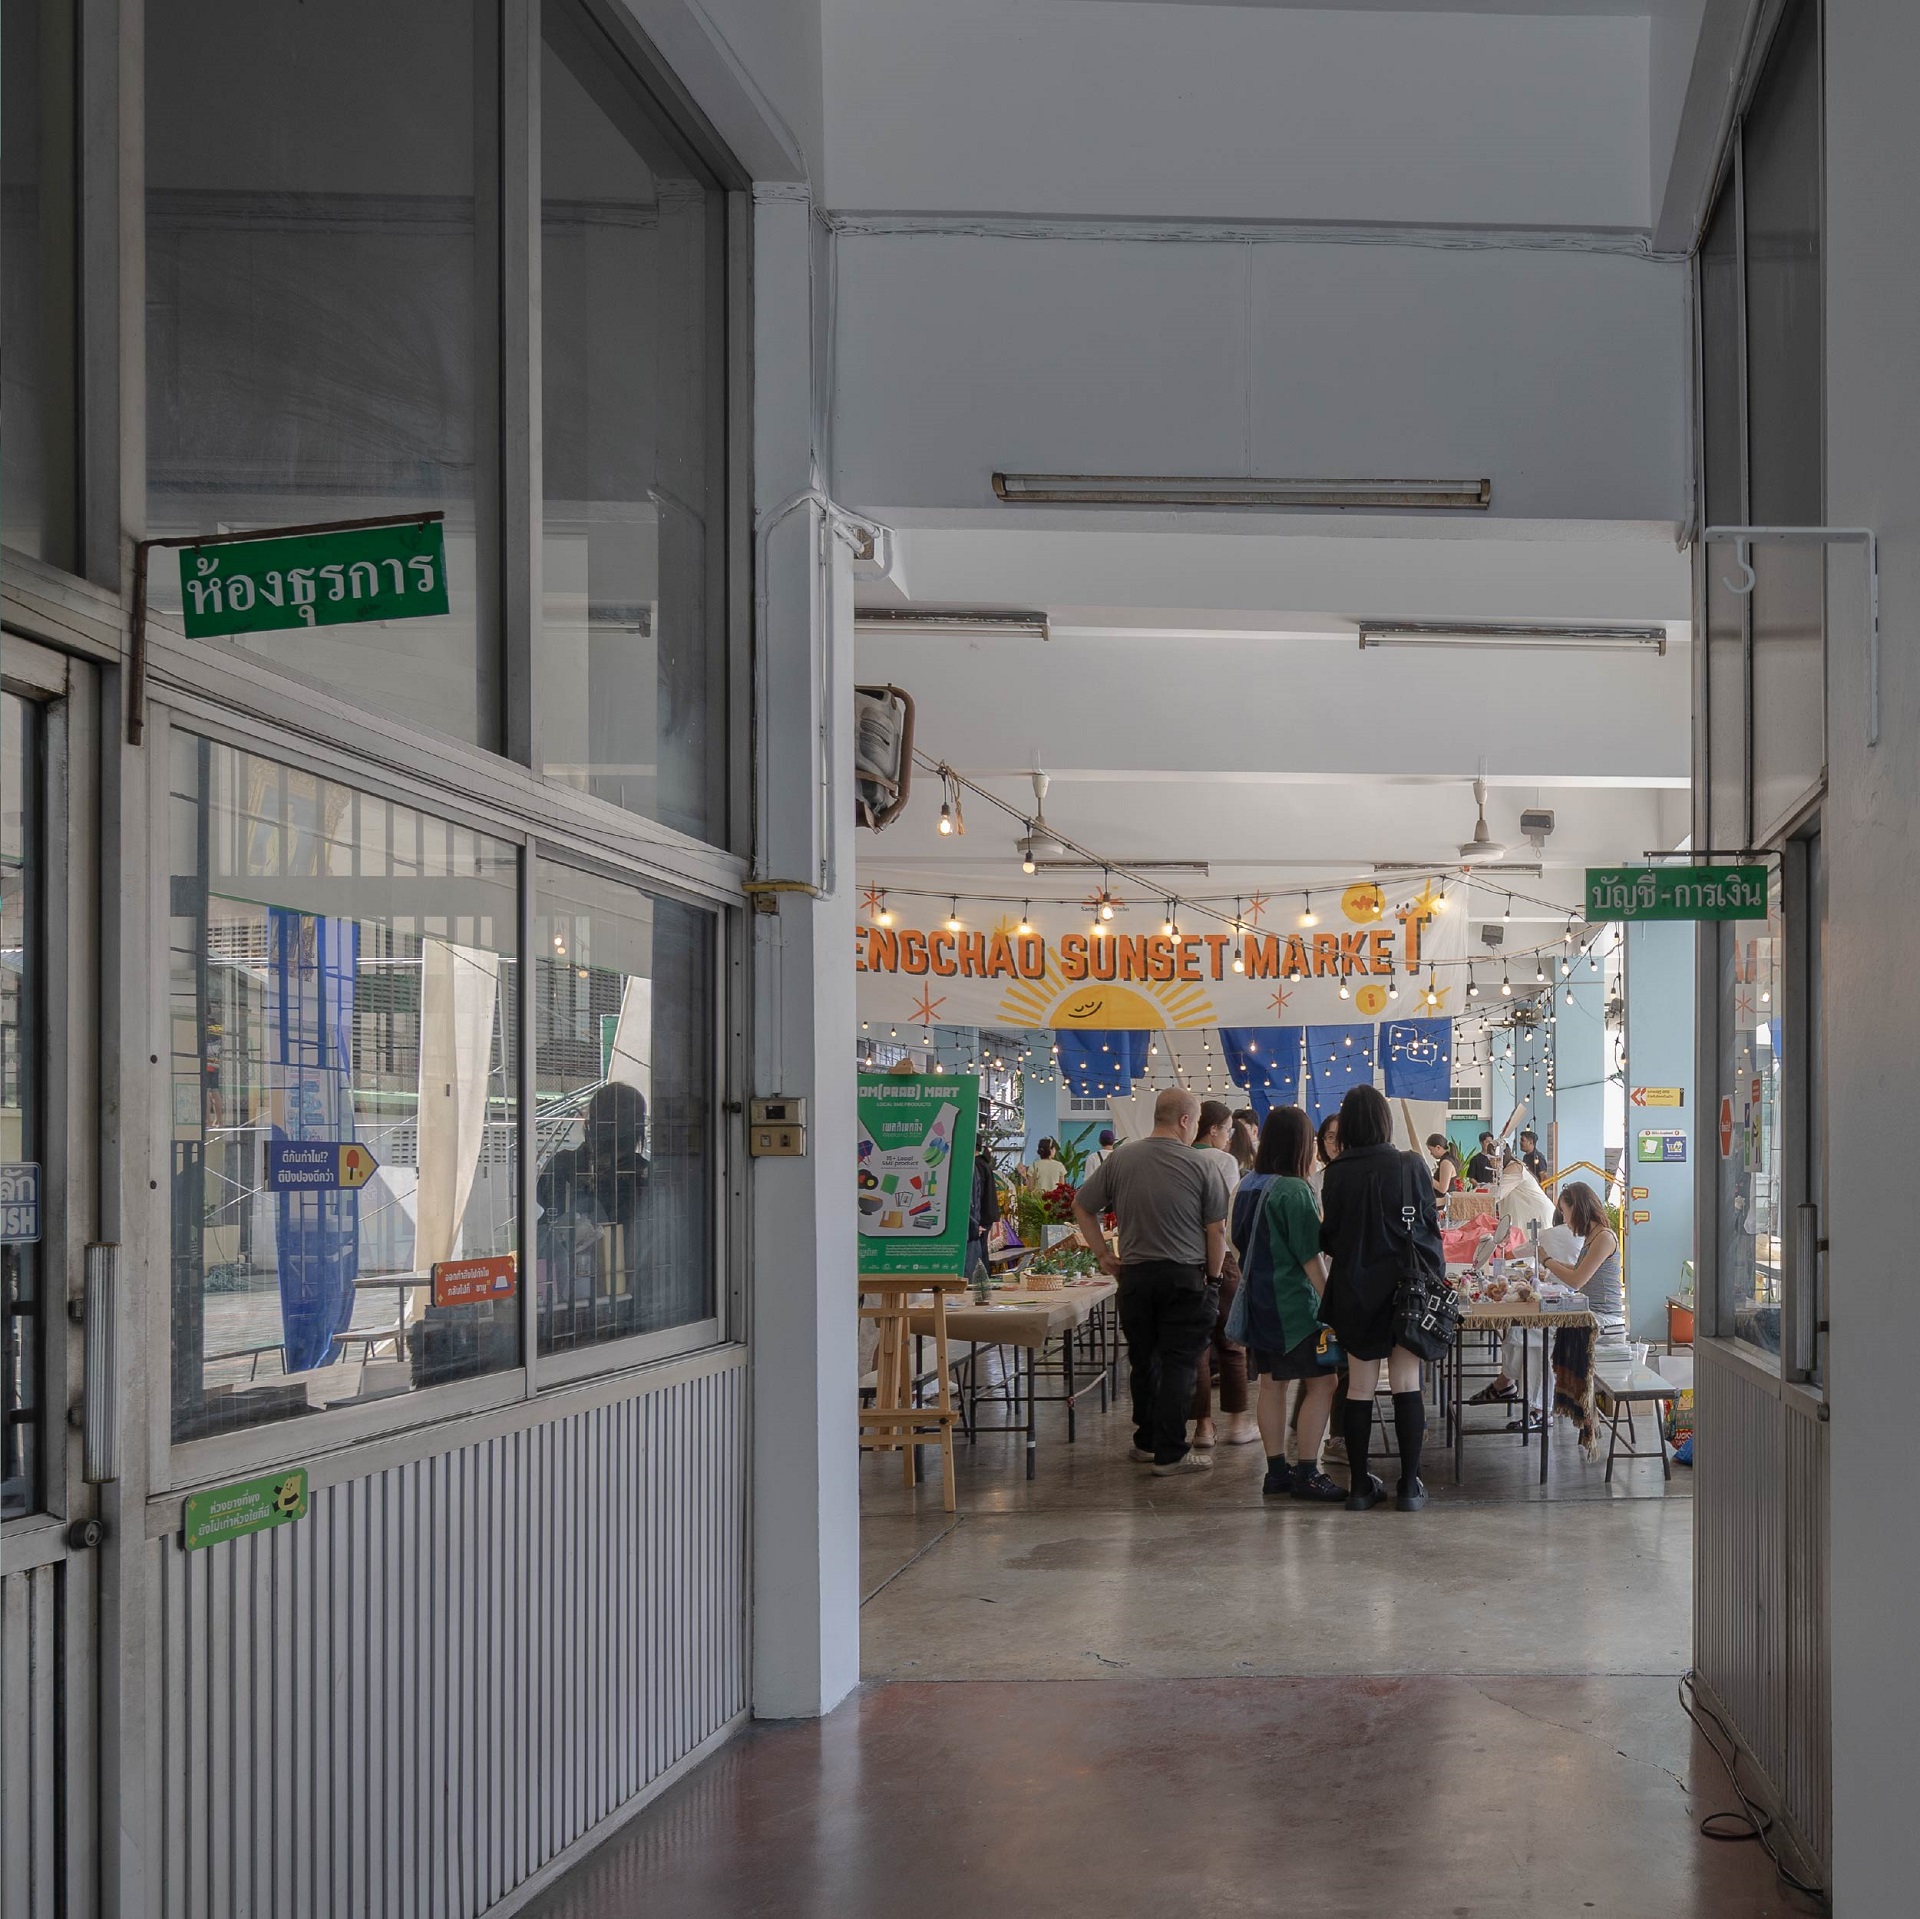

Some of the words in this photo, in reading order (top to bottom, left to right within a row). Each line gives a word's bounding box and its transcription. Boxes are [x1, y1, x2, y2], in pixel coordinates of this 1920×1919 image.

[186, 555, 434, 626] ห้องธุรการ
[1061, 933, 1230, 982] SUNSET
[1244, 907, 1432, 979] MARKET
[924, 1086, 960, 1098] MART
[278, 1168, 335, 1183] ตีปิงปองดีกว่า
